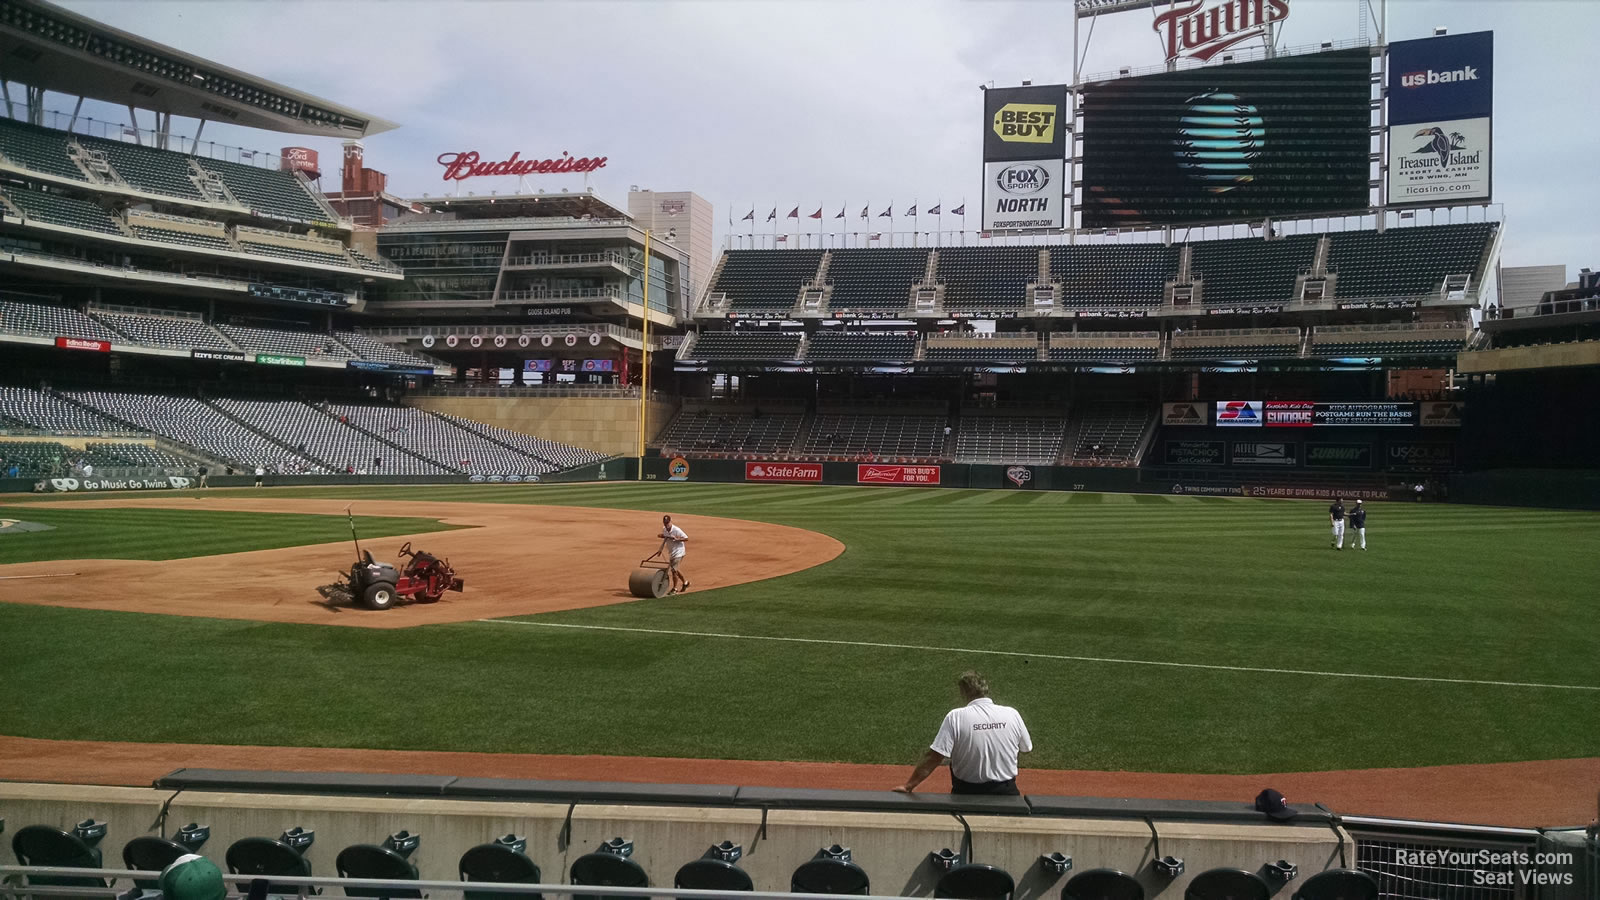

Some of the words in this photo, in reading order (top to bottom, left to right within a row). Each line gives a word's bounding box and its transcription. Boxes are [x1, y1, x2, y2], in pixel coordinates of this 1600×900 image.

[1153, 0, 1289, 62] Twins
[1001, 110, 1054, 124] BEST
[1003, 124, 1049, 137] BUY
[288, 149, 307, 160] Ford
[1398, 156, 1440, 170] Treasure
[1450, 151, 1479, 165] Island
[437, 151, 608, 181] Budweiser
[1007, 169, 1039, 183] FOX
[1007, 182, 1039, 190] SPORTS
[1406, 182, 1472, 194] ticasino.com
[996, 198, 1049, 213] NORTH
[993, 219, 1053, 229] FOXSPORTSNORTH.COM
[528, 308, 543, 316] GOOSE
[224, 353, 244, 361] CREAM
[1267, 411, 1312, 424] SUNDAYS
[1310, 447, 1361, 459] SUBWAY
[1018, 470, 1030, 480] 29
[83, 479, 98, 489] Go
[100, 479, 127, 489] Music
[129, 479, 142, 489] Go
[142, 479, 167, 488] Twins
[1253, 486, 1265, 495] 25
[1296, 488, 1314, 496] GIVING
[1316, 489, 1330, 497] KIDS
[1337, 490, 1360, 498] CHANCE
[973, 722, 1006, 731] SECURITY
